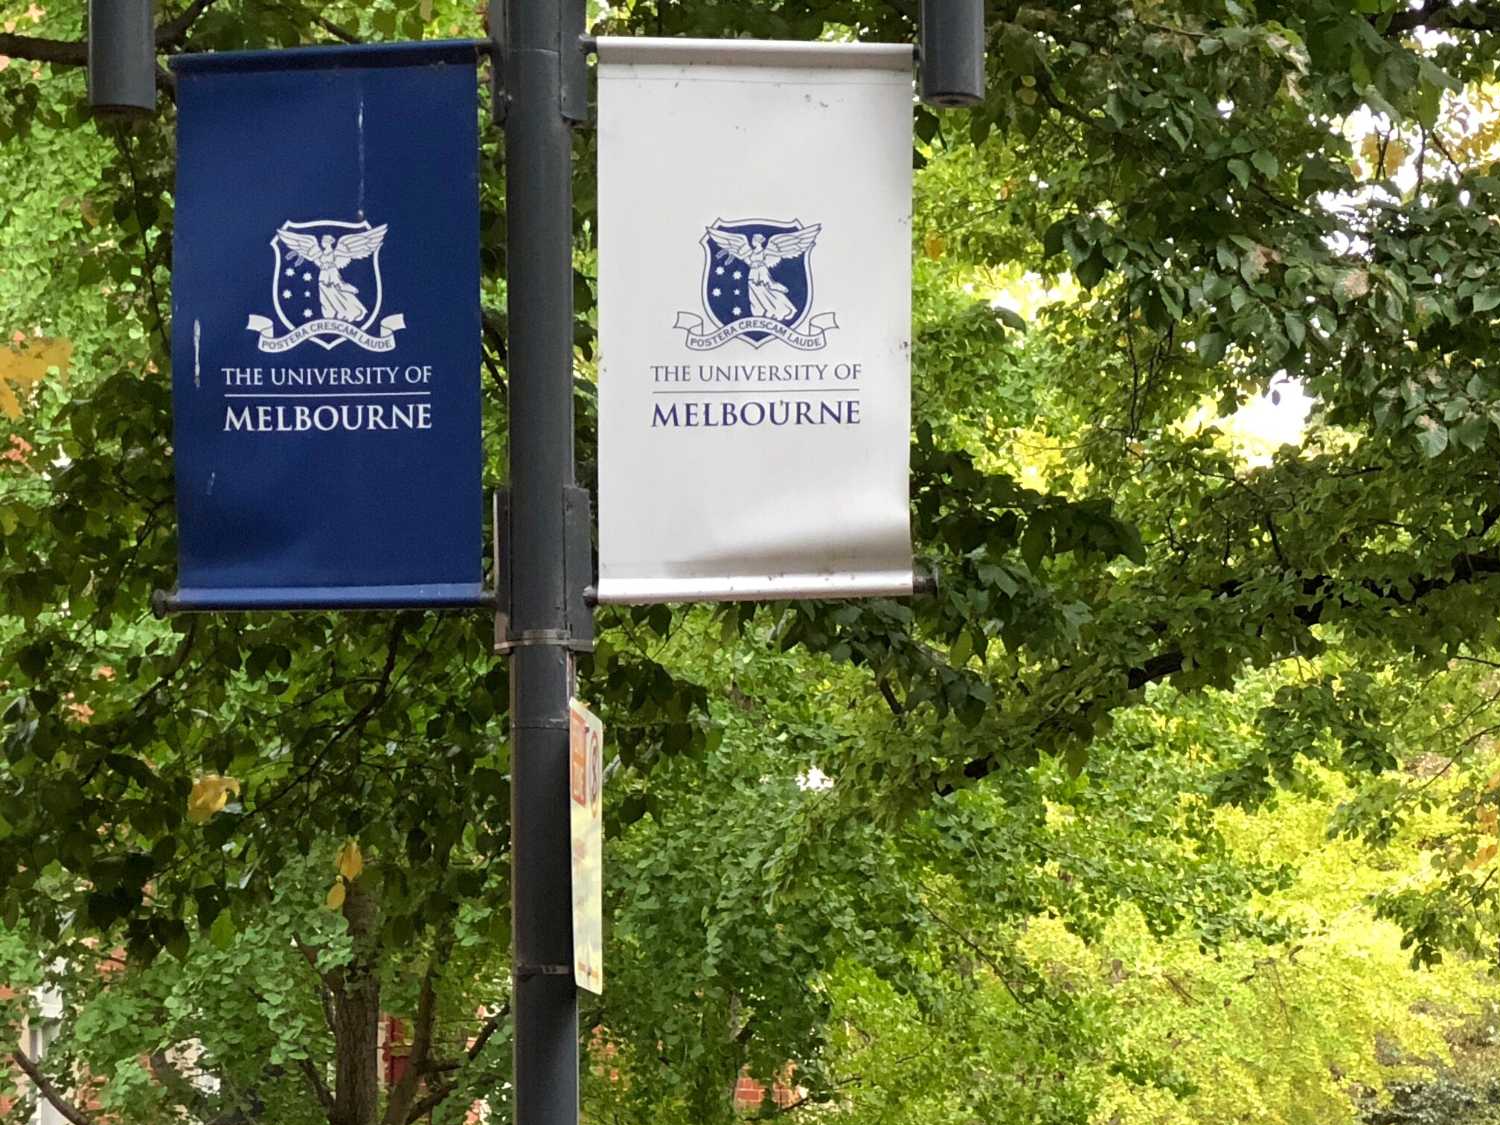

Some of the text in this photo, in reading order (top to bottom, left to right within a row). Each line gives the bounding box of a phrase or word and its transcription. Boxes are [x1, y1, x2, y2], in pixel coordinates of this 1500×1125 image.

[261, 322, 393, 350] POSTERA CRESCAM LAUDE
[689, 319, 823, 348] POSTERA CRESCAM LAUDE
[221, 365, 432, 386] THE UNIVERSITY OF
[650, 363, 862, 382] THE UNIVERSITY OF
[223, 403, 432, 432] MELBOURNE
[651, 400, 861, 427] MELBOURNE
